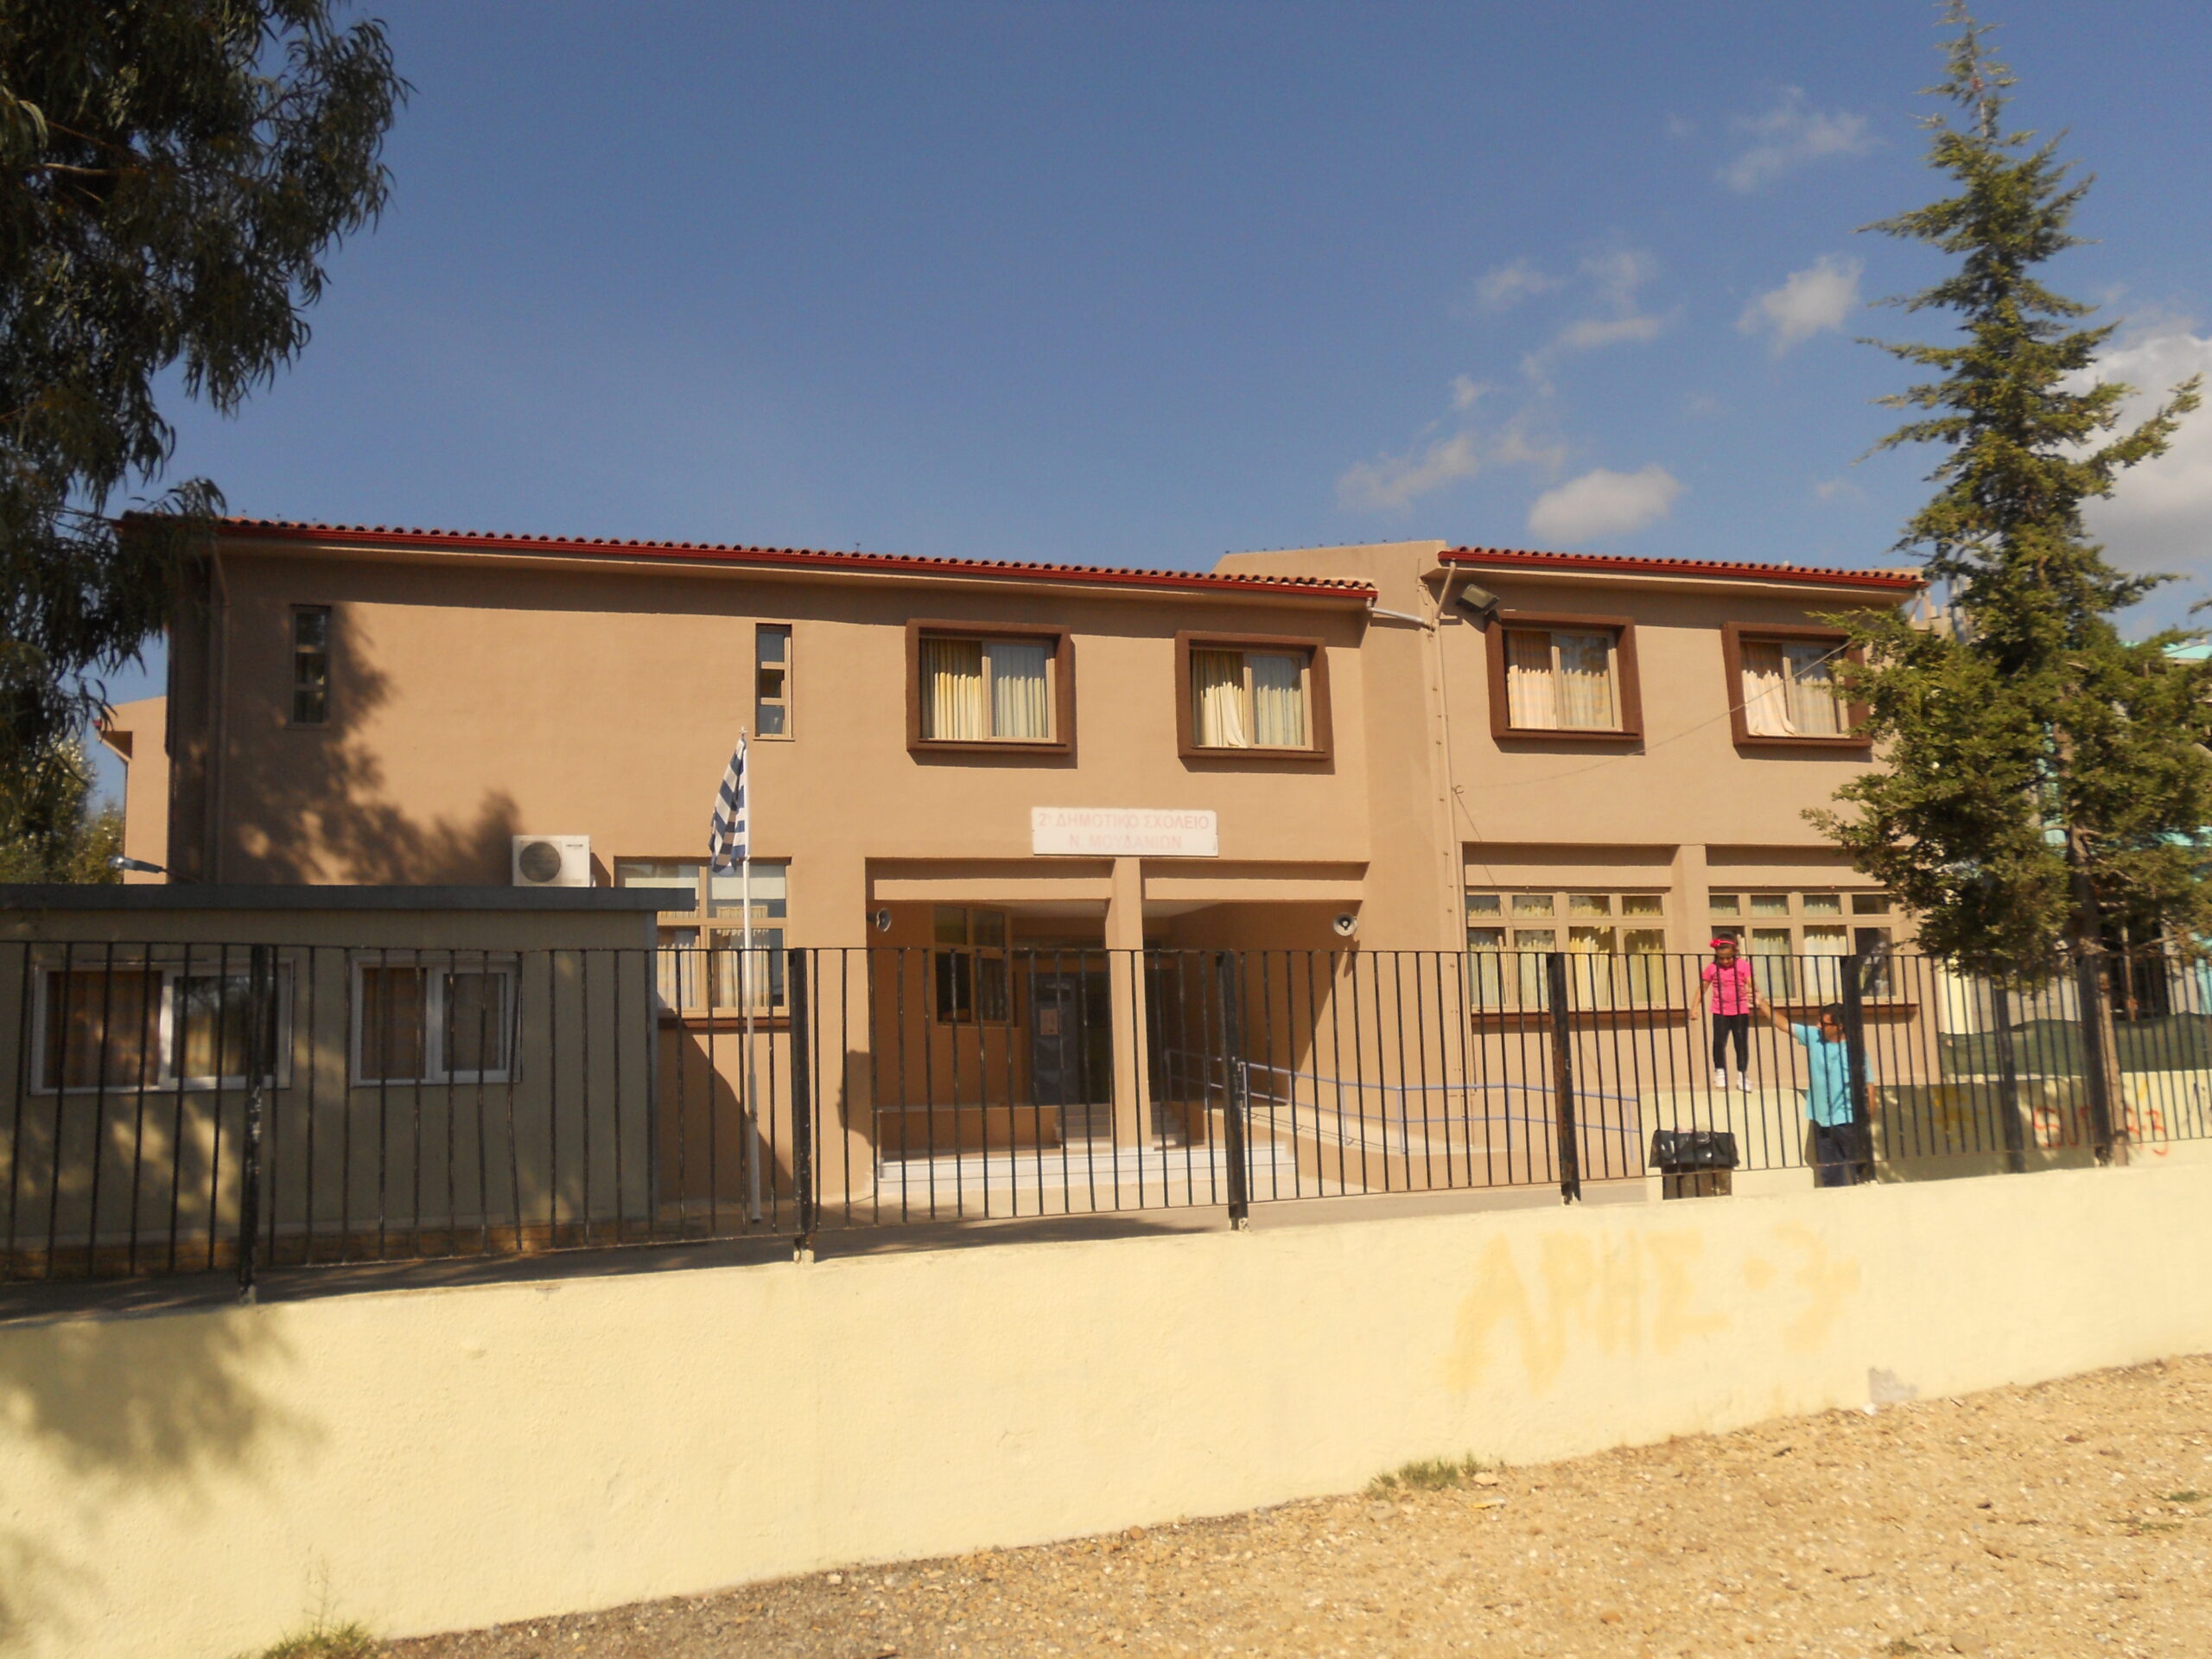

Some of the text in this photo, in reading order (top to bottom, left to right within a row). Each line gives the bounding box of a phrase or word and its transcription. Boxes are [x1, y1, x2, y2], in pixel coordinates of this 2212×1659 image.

[1056, 813, 1140, 829] ΔΗΜΟΤΙΚΟ
[1143, 815, 1209, 830] ΣΧΟΛΕΙΟ
[1090, 834, 1182, 849] ΜΟΥΔΑΝΙΩΝ
